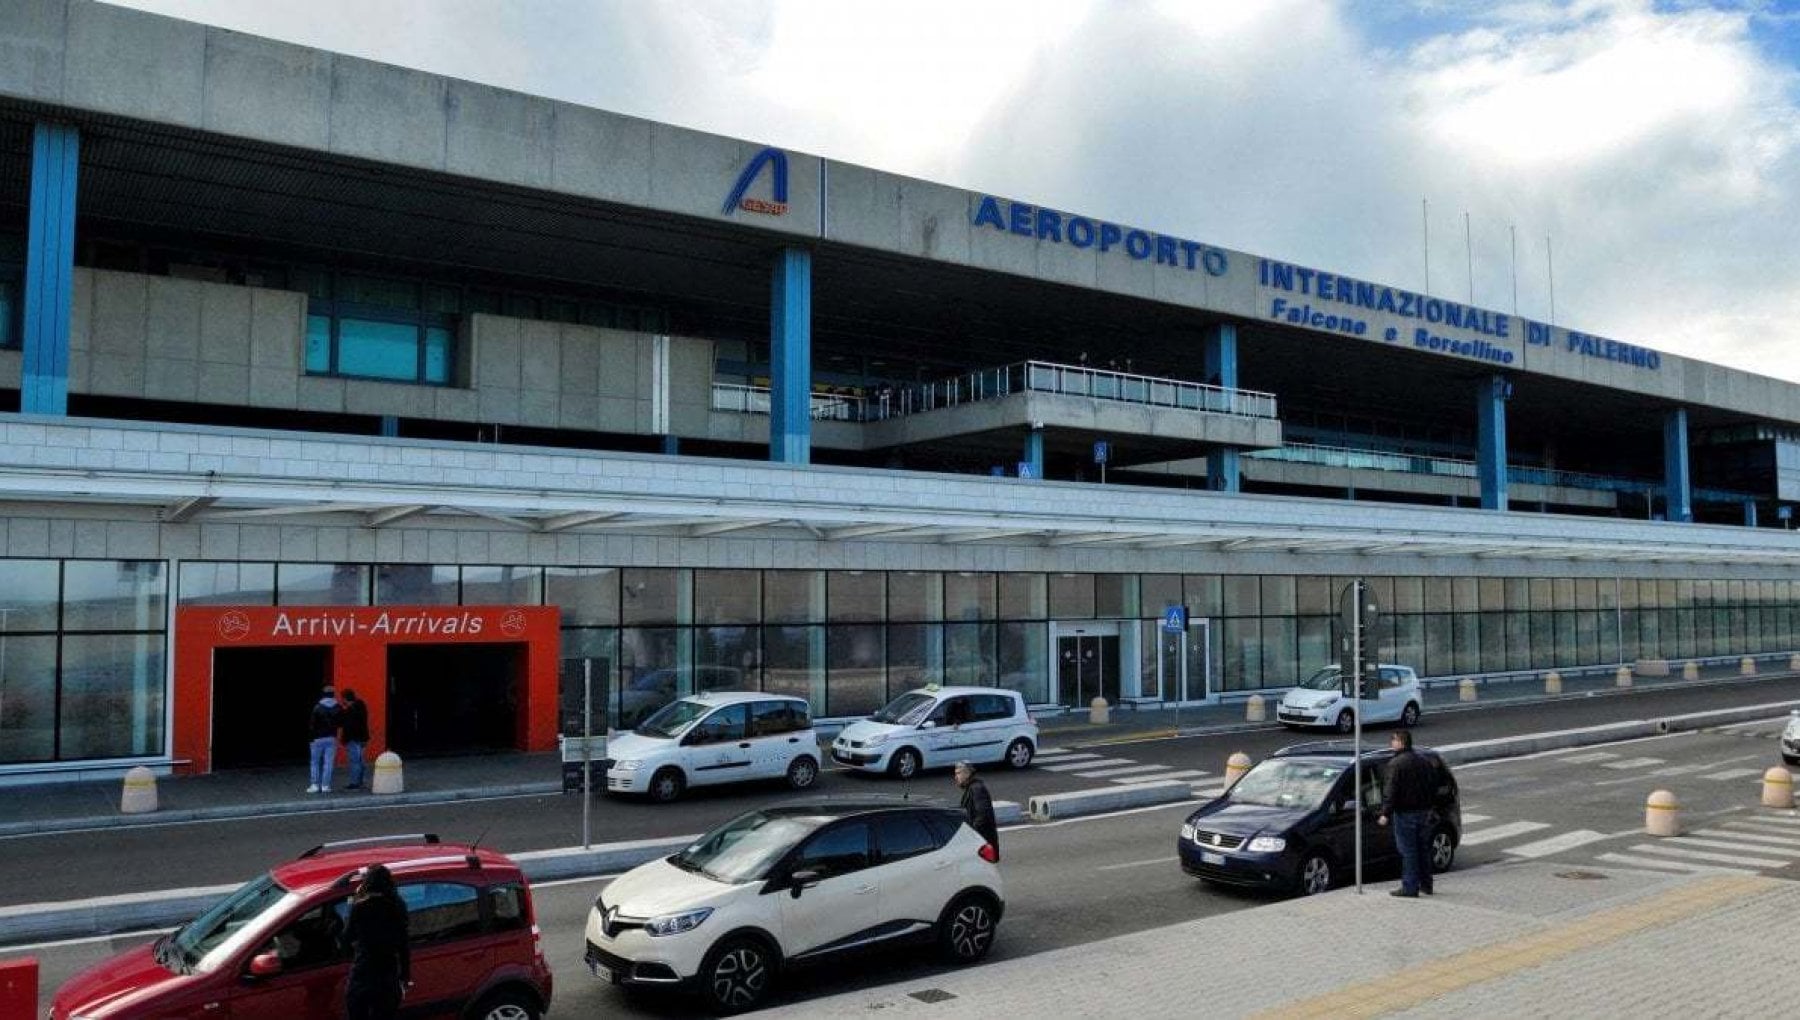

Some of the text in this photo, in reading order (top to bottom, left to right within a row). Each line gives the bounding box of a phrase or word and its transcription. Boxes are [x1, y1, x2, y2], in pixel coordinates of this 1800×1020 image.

[974, 195, 1661, 370] AEROPORTO INTERNAZIONALE DI PALERMO
[1384, 327, 1398, 341] e
[1415, 327, 1514, 364] Borsellino
[272, 612, 483, 637] Arrivi-Arrivals
